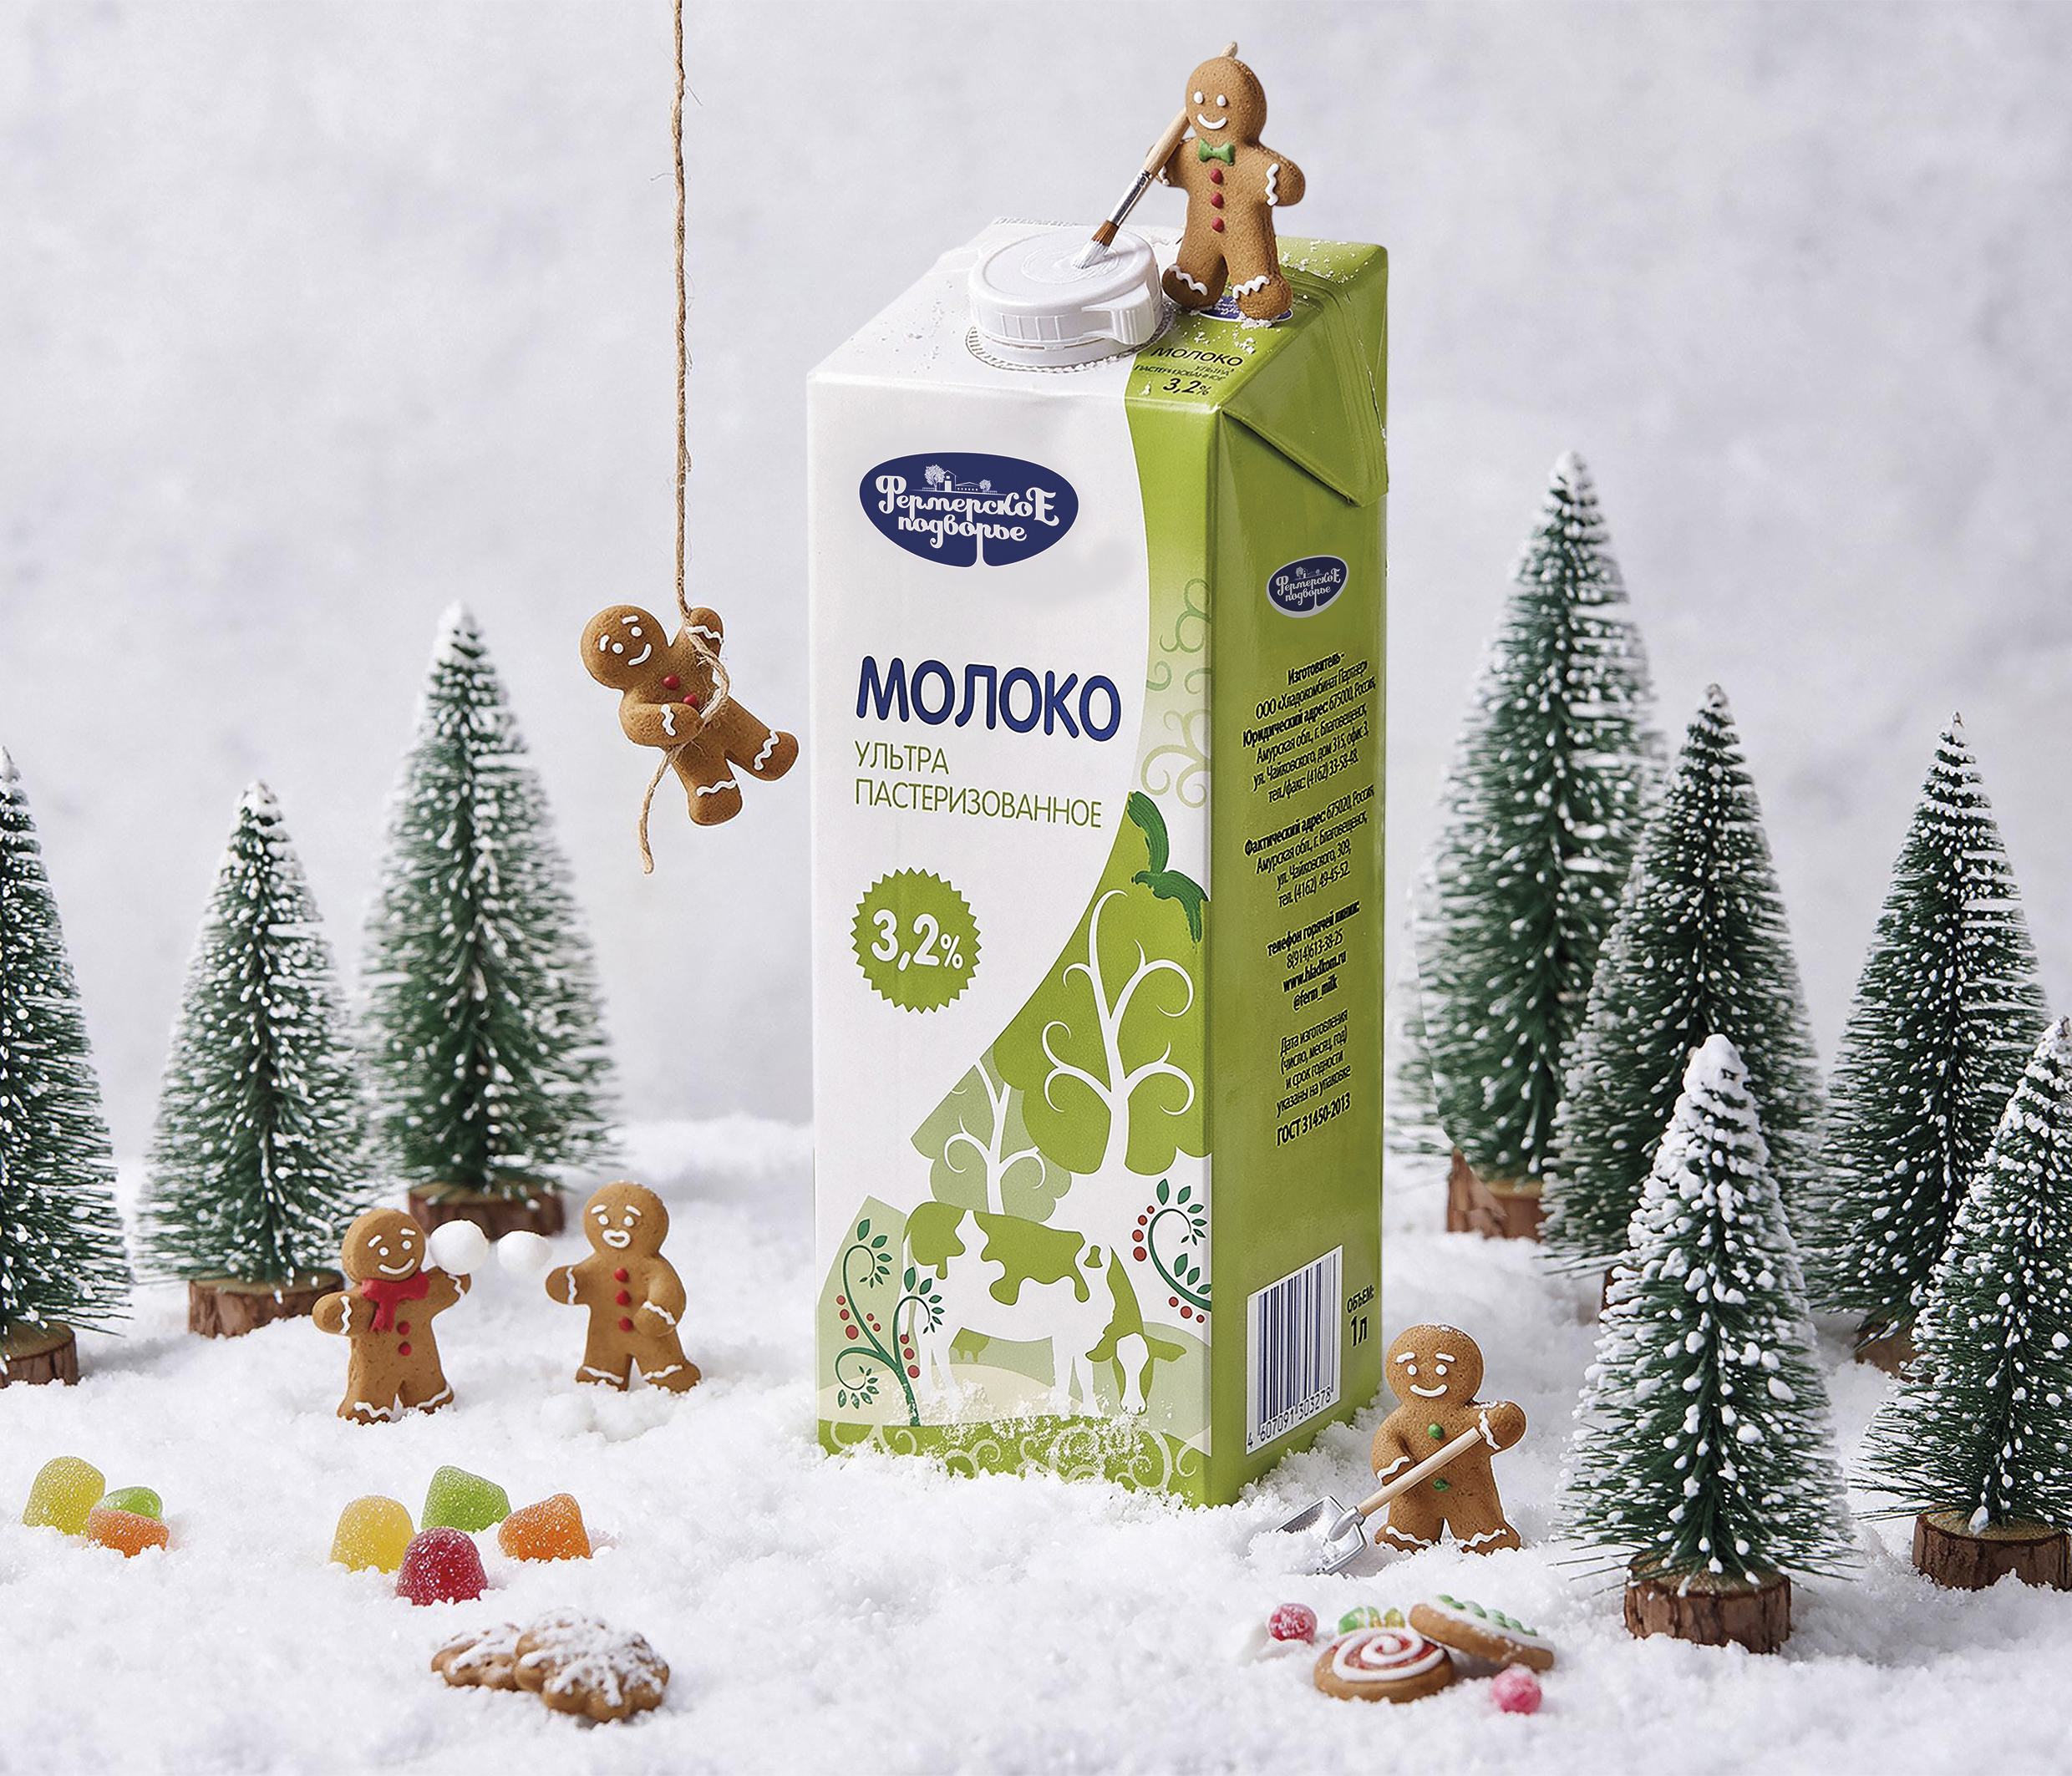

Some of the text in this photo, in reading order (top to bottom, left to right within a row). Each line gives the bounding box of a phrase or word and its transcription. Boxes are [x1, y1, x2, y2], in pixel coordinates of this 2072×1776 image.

[1150, 348, 1243, 366] МОЛОКО
[1163, 378, 1211, 395] 3,2%
[898, 512, 1027, 550] подворье
[856, 655, 1120, 742] МОЛОКО
[1256, 698, 1277, 719] ООО
[855, 740, 949, 775] УЛЬТРА
[855, 779, 1102, 828] ПАСТЕРИЗОВАННОЕ
[871, 908, 963, 971] 3,2%
[1280, 1036, 1298, 1057] Дата
[1277, 1092, 1350, 1146] ГОСТ 31450-2013
